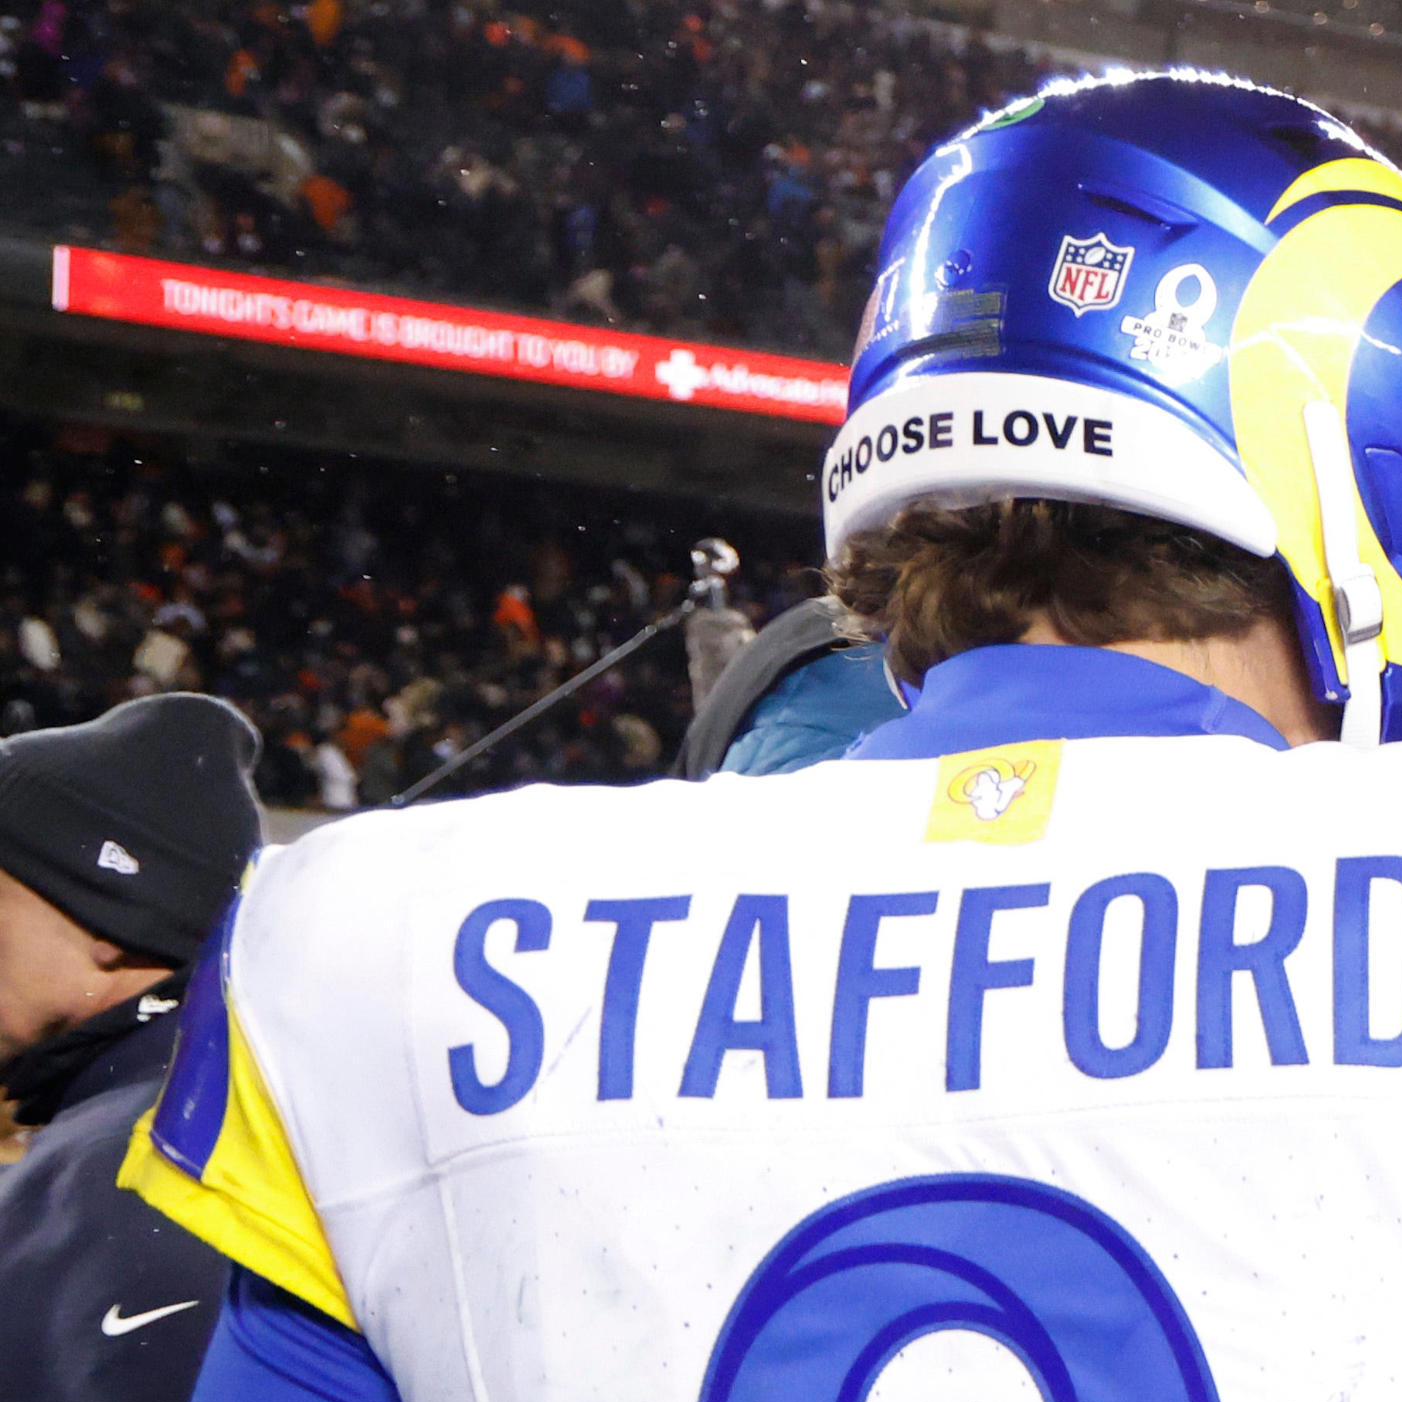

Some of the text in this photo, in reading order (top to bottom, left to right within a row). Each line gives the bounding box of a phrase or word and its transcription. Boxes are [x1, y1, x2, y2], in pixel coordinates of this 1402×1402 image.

[1059, 265, 1110, 301] NFL
[292, 299, 369, 341] GAME
[400, 315, 514, 362] BROUGHT
[517, 332, 551, 368] TO
[552, 339, 599, 376] YOU
[600, 345, 639, 379] BY
[828, 410, 1114, 503] CHOOSE LOVE
